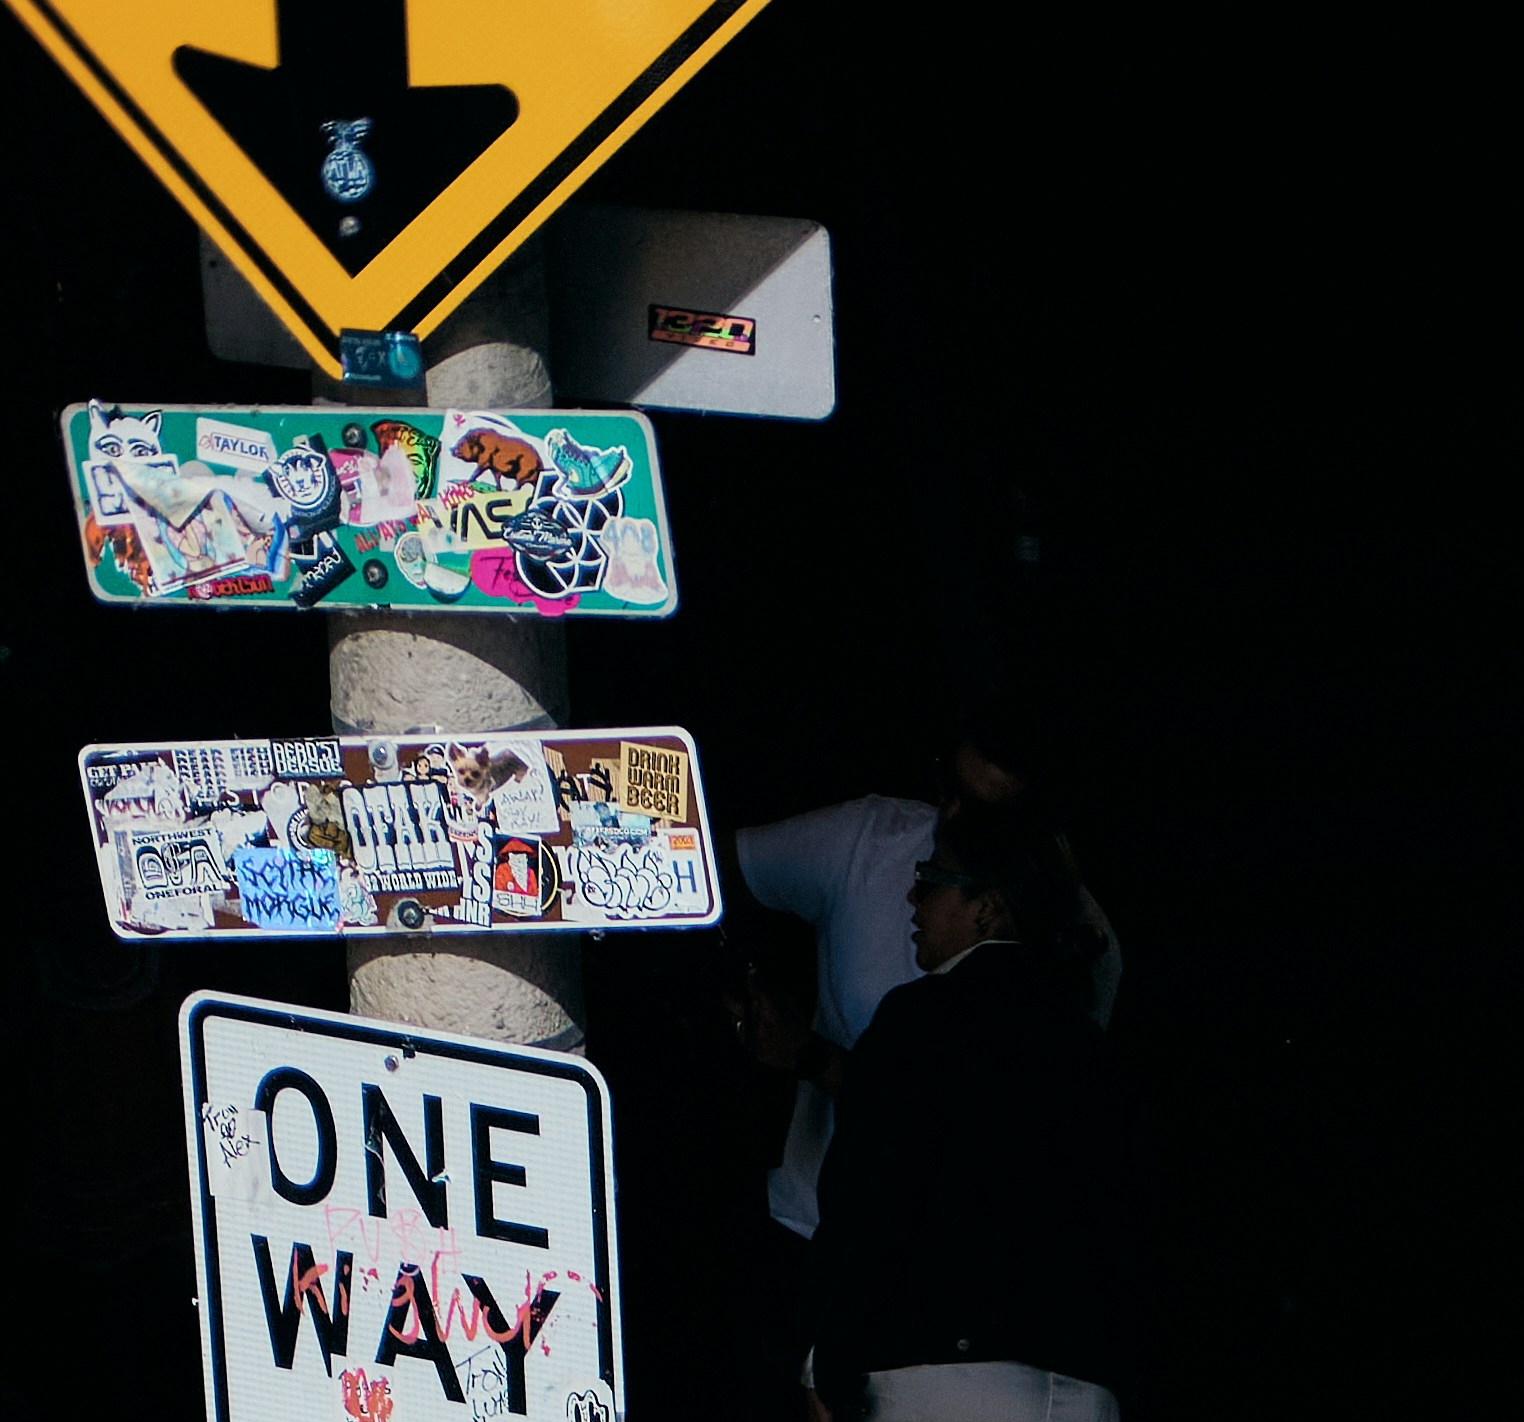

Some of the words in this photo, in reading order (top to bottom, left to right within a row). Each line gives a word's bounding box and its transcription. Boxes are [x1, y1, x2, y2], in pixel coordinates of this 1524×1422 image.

[656, 309, 753, 342] 1320
[213, 435, 270, 462] TAYLOR
[628, 747, 680, 775] DRINK
[628, 766, 680, 794] WARM
[627, 785, 679, 815] BEER
[132, 828, 212, 845] NORTHWEST
[379, 871, 424, 892] WORLD
[242, 886, 340, 924] MORGUE
[253, 1065, 549, 1249] ONE
[250, 1233, 561, 1416] WAY
